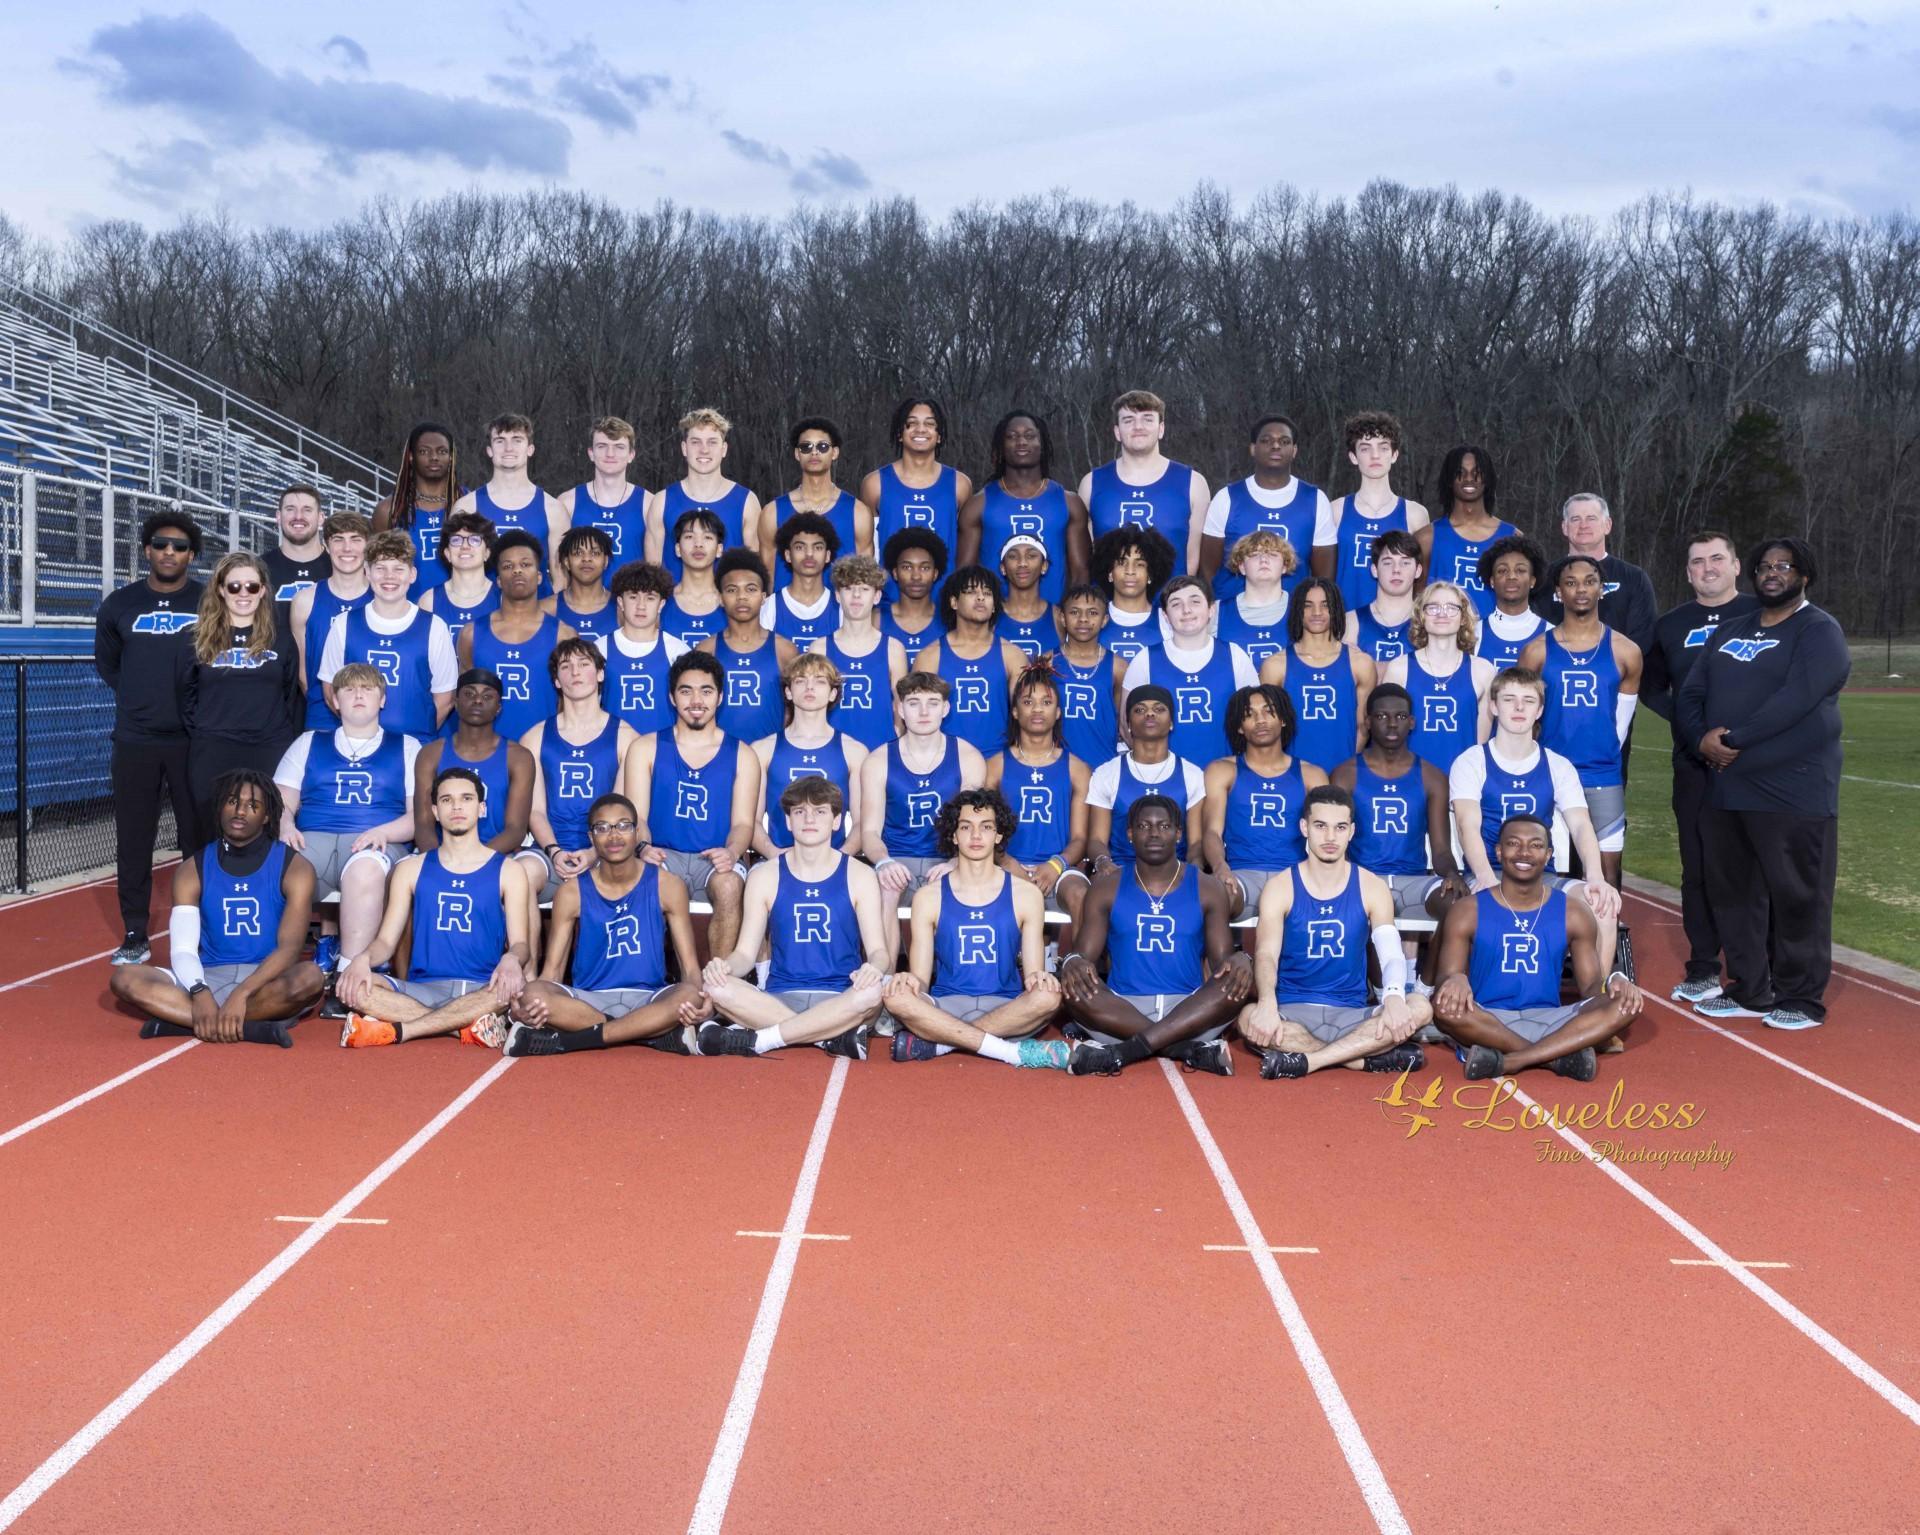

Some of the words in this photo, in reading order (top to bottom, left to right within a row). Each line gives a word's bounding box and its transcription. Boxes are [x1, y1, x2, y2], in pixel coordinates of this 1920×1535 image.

[1454, 556, 1484, 591] R
[152, 611, 174, 634] R
[497, 664, 529, 700] R
[621, 675, 653, 709] R
[727, 671, 760, 705] R
[840, 675, 872, 708] R
[956, 677, 989, 711] R
[1562, 671, 1597, 706] R
[1065, 684, 1096, 719] R
[1176, 687, 1212, 722] R
[1303, 685, 1336, 719] R
[1424, 696, 1457, 731] R
[336, 771, 372, 804] R
[560, 762, 593, 798] R
[675, 781, 708, 820] R
[908, 791, 941, 827] R
[1020, 786, 1052, 823] R
[1250, 793, 1286, 827] R
[1373, 797, 1408, 833] R
[223, 897, 260, 935] R
[437, 892, 472, 932] R
[794, 903, 831, 942] R
[606, 914, 641, 958] R
[959, 925, 997, 964] R
[1136, 914, 1175, 952] R
[1307, 920, 1345, 958] R
[1501, 933, 1539, 973] R
